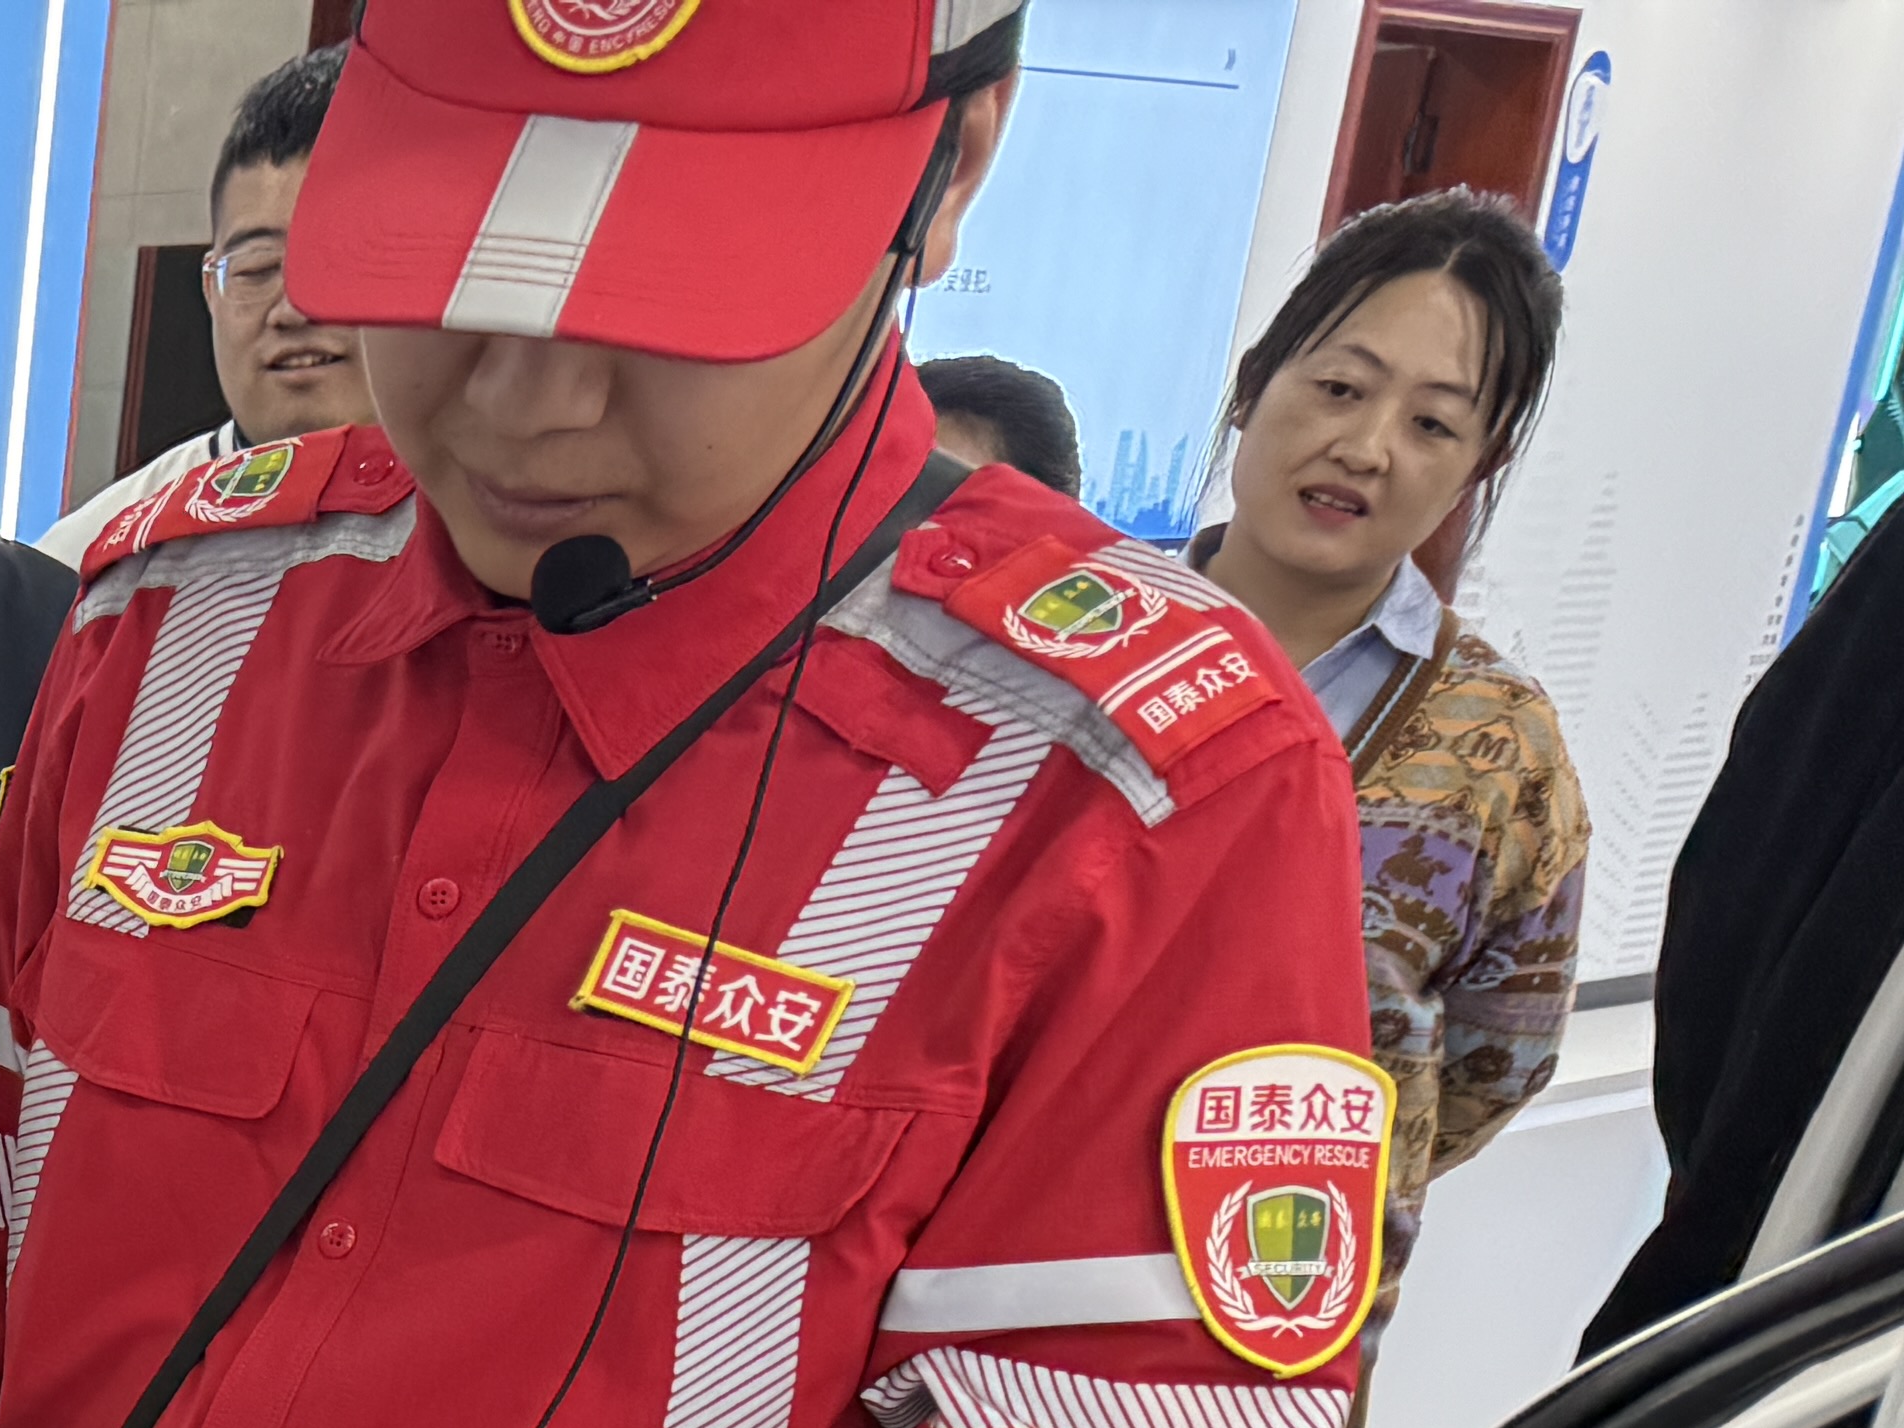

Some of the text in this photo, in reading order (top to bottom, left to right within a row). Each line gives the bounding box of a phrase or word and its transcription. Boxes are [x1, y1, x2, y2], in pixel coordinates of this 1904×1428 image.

[1137, 652, 1259, 735] 国泰众安
[602, 937, 823, 1052] 国泰众安
[1195, 1083, 1376, 1135] 国泰众安
[1188, 1144, 1371, 1169] EMERGENCY RESCUE
